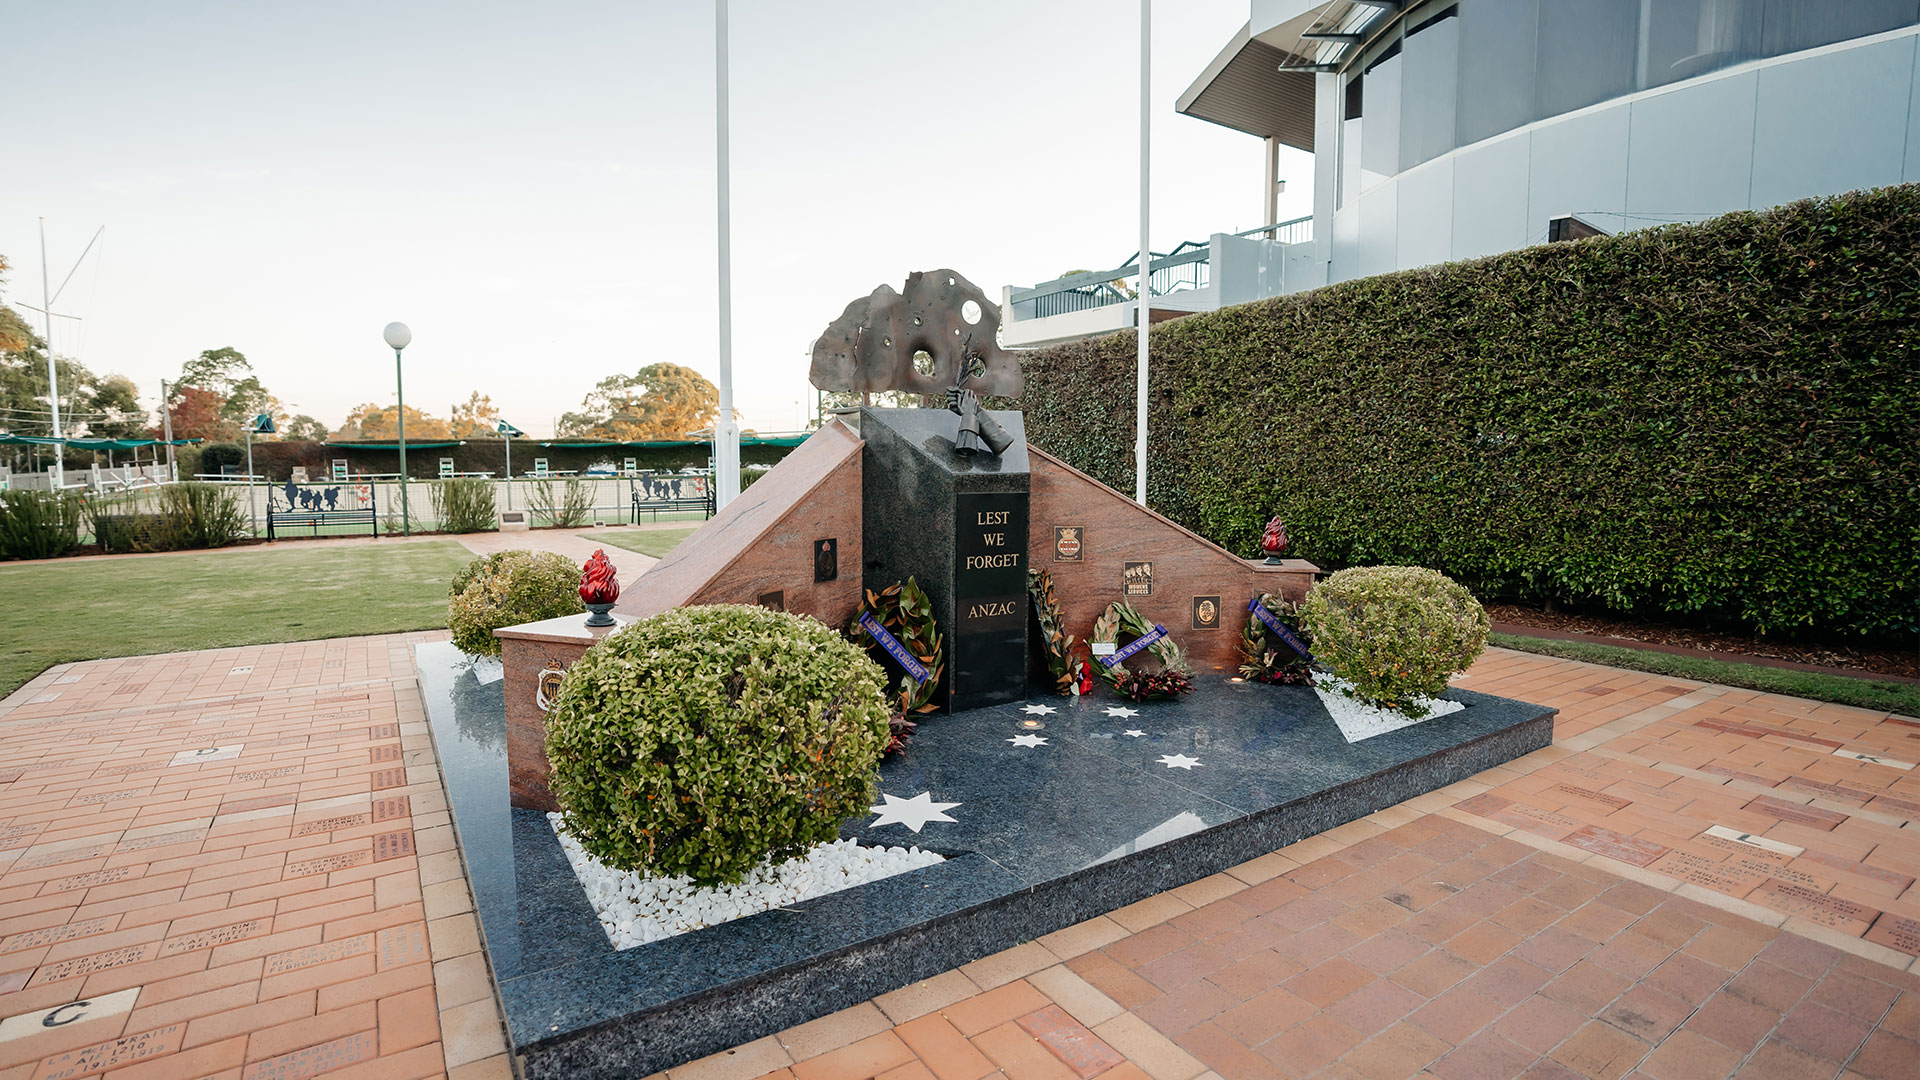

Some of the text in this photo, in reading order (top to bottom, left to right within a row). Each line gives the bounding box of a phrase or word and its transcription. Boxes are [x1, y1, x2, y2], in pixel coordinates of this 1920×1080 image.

[977, 511, 1010, 525] LEST
[984, 533, 1005, 546] WE
[966, 553, 1020, 570] FORGET
[968, 601, 1016, 618] ANZAC
[1254, 605, 1273, 622] LEST
[1272, 621, 1286, 635] WE
[864, 617, 925, 677] LEST WE FORGET
[1108, 651, 1126, 664] LEST
[1126, 644, 1138, 654] WE
[196, 747, 219, 756] D
[1736, 834, 1762, 846] L
[42, 1001, 92, 1027] C
